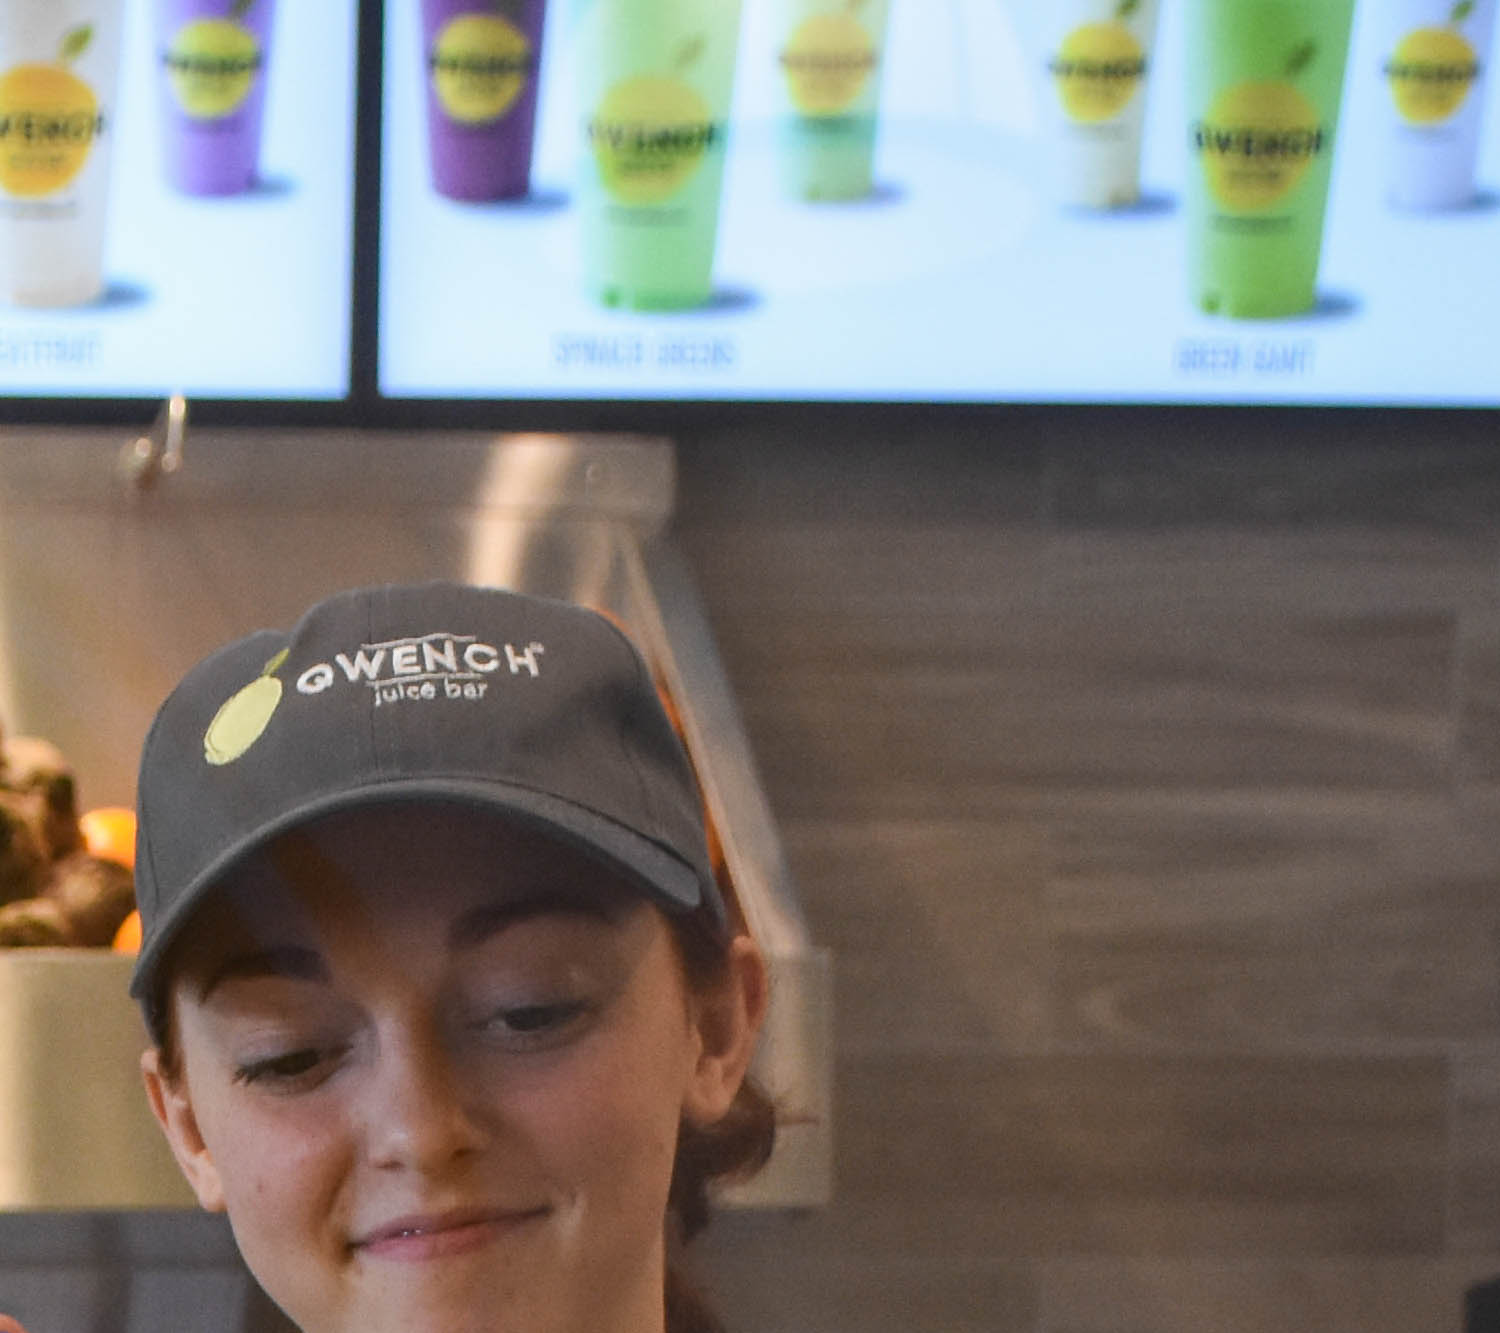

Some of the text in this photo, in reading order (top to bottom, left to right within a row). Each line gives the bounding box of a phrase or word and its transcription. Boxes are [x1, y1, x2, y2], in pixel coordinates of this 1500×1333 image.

[296, 639, 541, 694] QWENCH
[374, 676, 489, 707] juice bar
